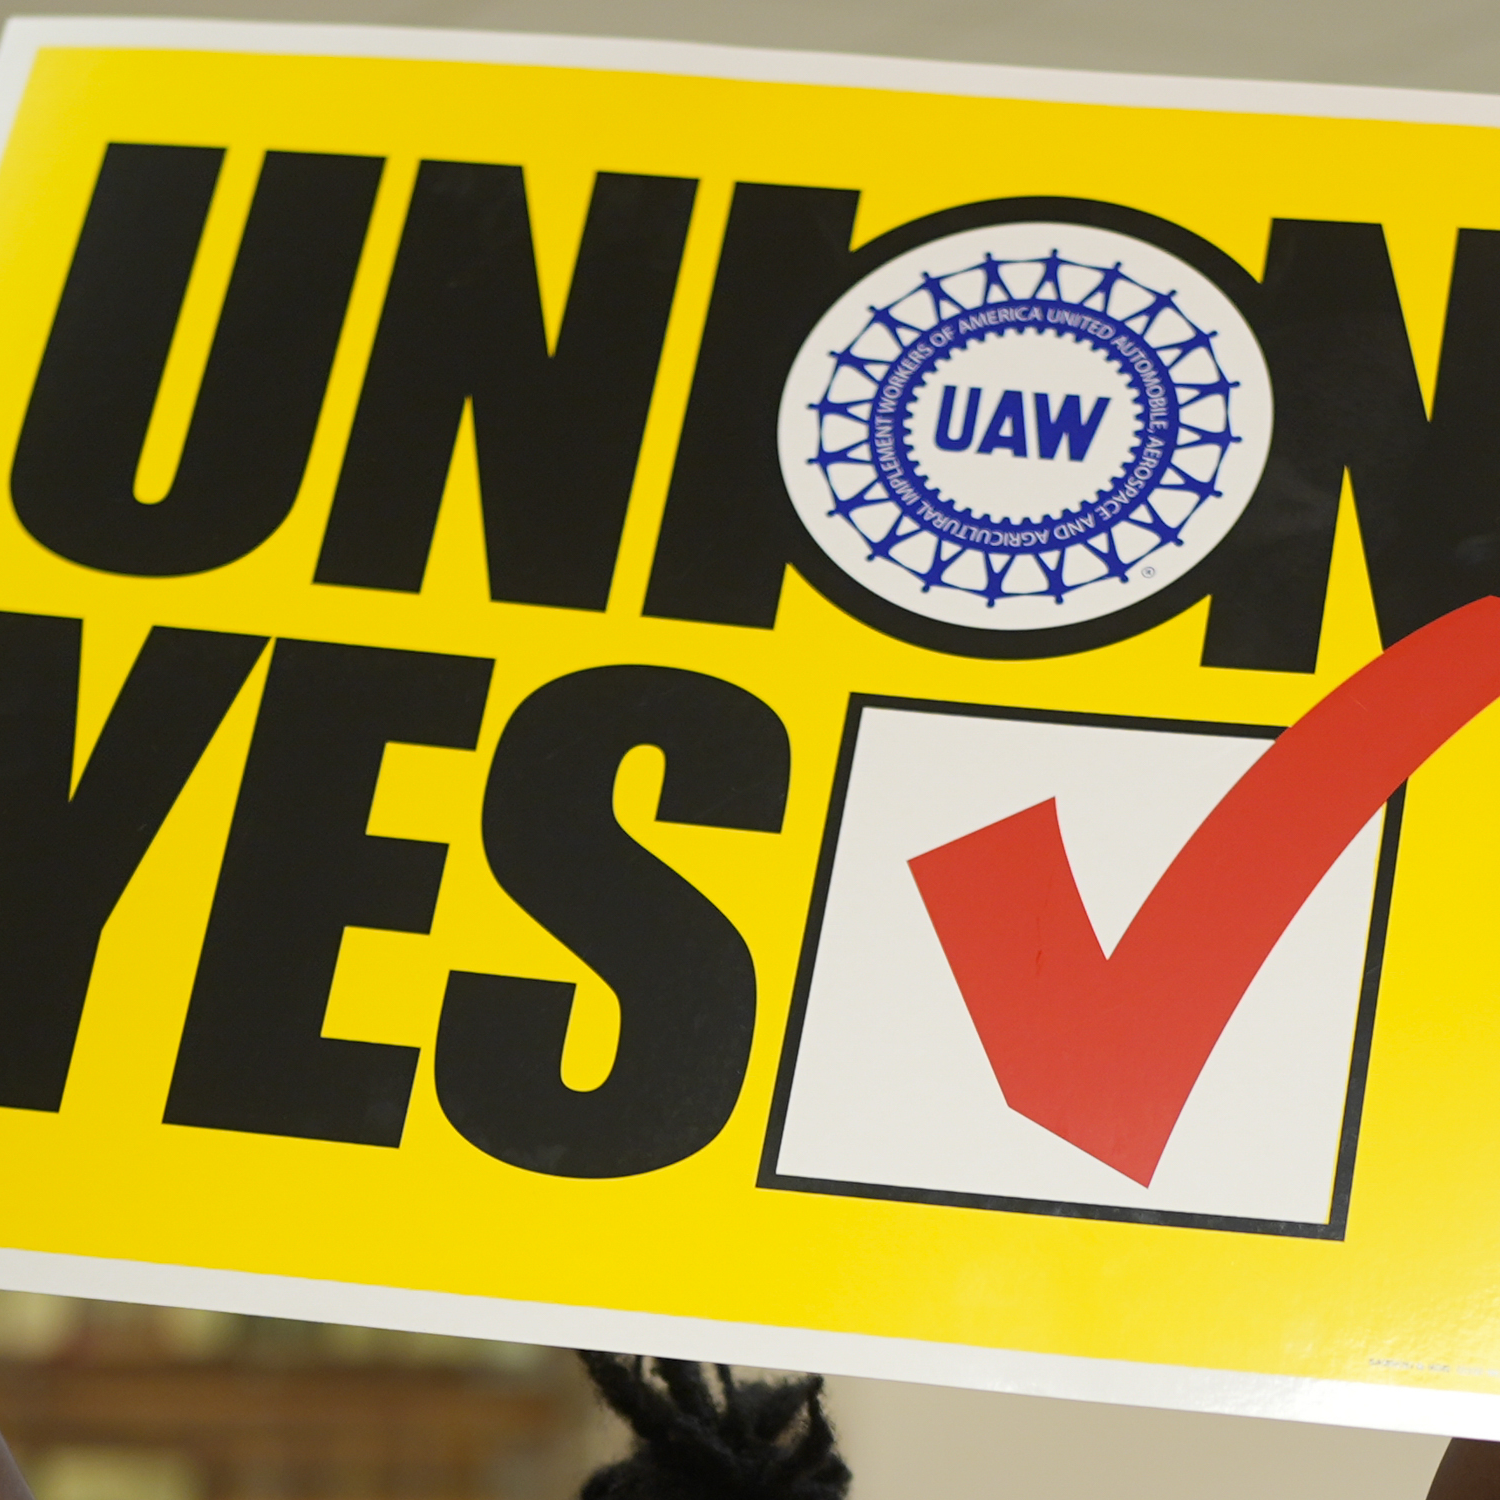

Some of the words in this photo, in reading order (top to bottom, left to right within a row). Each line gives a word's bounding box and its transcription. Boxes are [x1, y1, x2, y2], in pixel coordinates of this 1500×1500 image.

[929, 326, 956, 347] OF
[957, 306, 1045, 334] AMERICA
[1046, 307, 1116, 340] UNITED
[878, 341, 934, 414] WORKERS
[1112, 335, 1170, 435] AUTOMOBILE,
[933, 384, 1112, 463] UAW
[874, 415, 922, 506] IMPLEMENT
[1099, 436, 1164, 521] AEROSPACE
[916, 502, 1050, 547] AGRICULTURAL
[1054, 513, 1096, 541] AND
